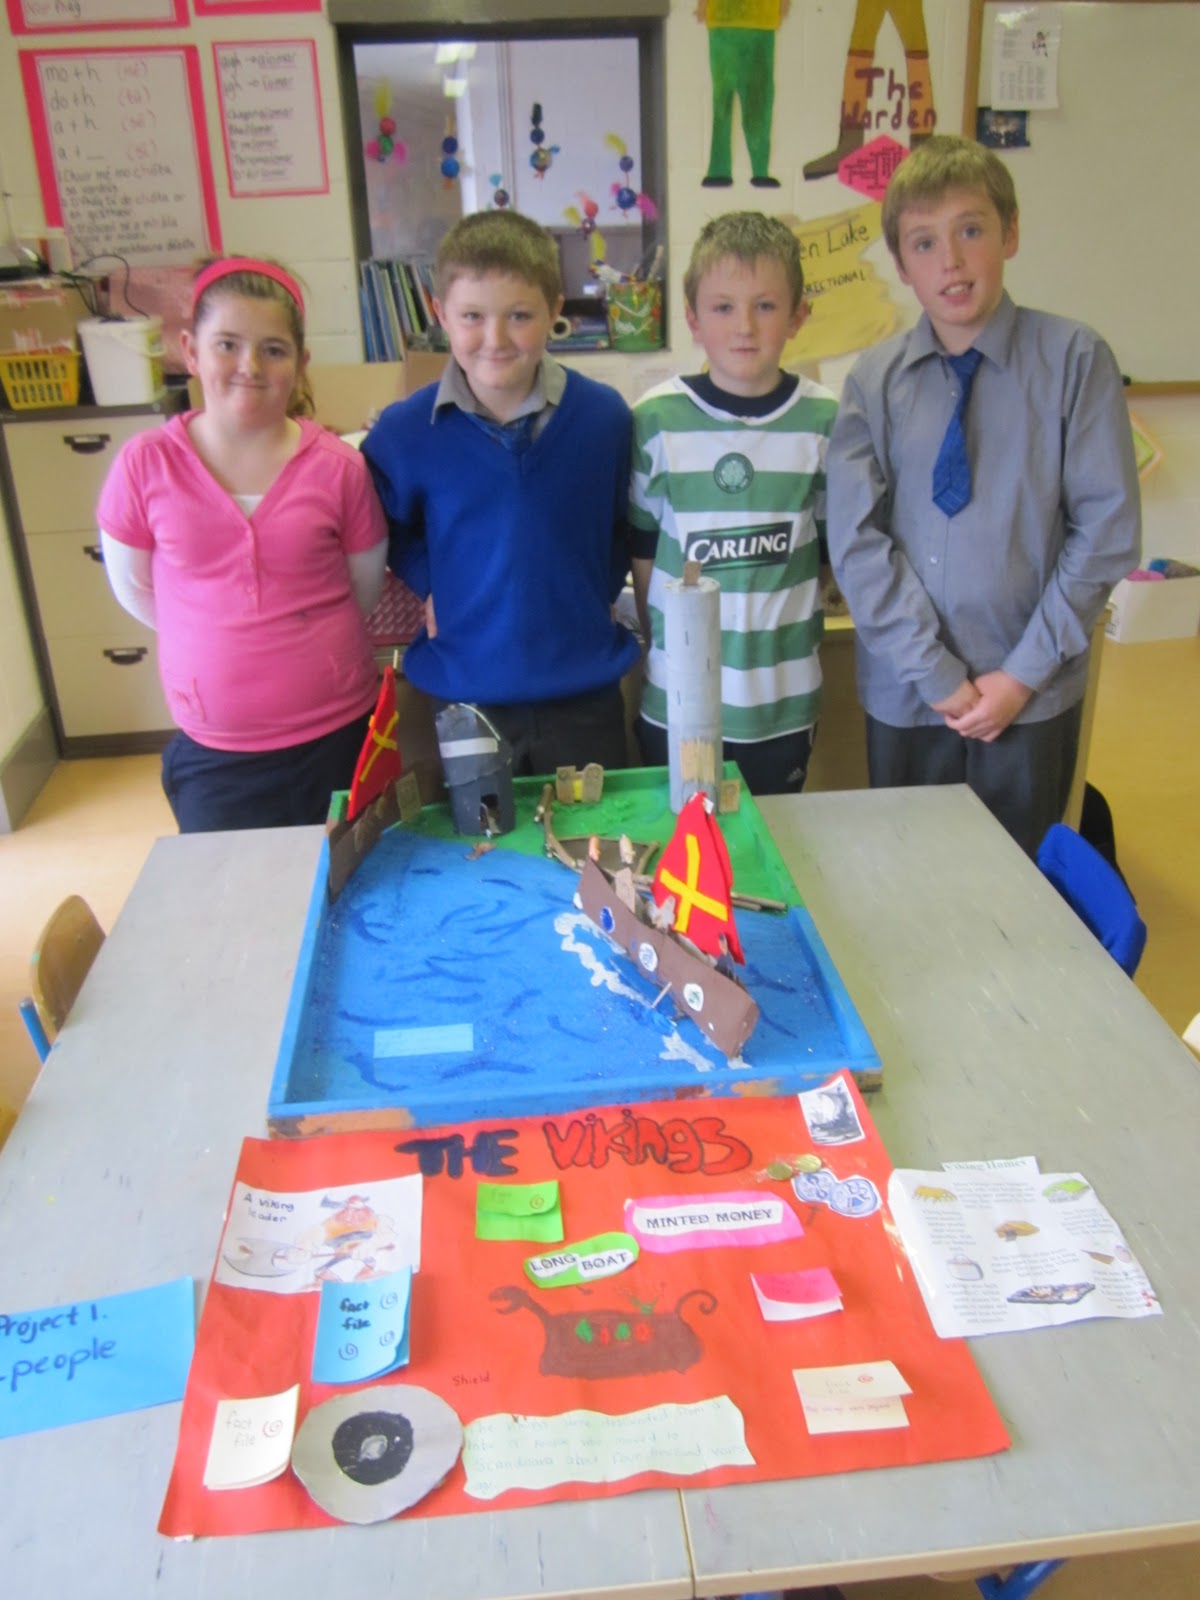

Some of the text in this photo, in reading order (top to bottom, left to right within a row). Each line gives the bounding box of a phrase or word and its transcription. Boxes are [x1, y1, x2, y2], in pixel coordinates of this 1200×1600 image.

[855, 67, 923, 101] The
[827, 224, 871, 255] Lake
[687, 533, 787, 564] CARLING
[394, 1129, 519, 1178] THE
[645, 1208, 774, 1229] MINTED MONEY
[530, 1251, 628, 1272] LONG BOAT
